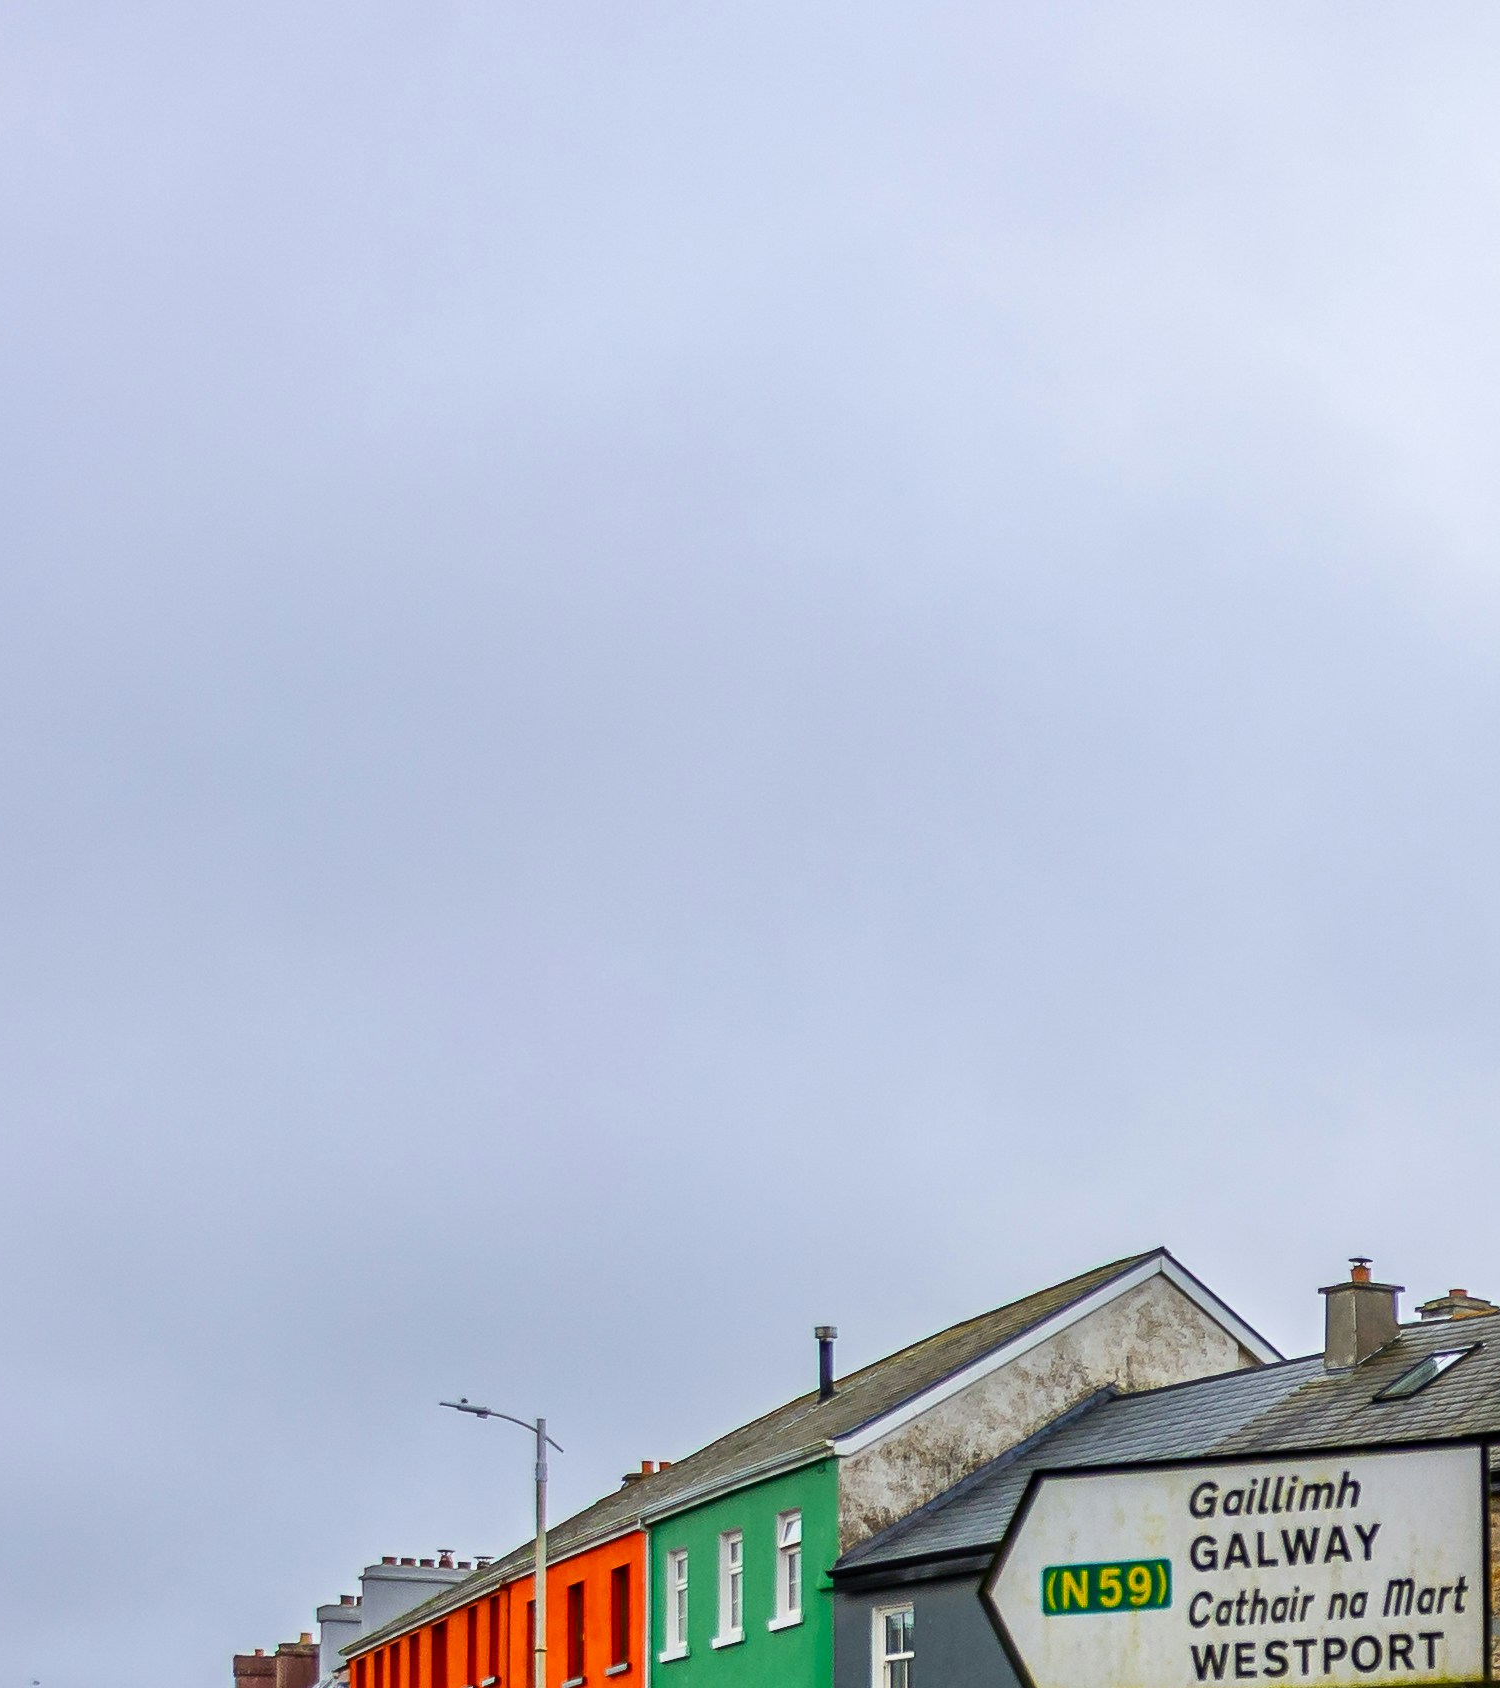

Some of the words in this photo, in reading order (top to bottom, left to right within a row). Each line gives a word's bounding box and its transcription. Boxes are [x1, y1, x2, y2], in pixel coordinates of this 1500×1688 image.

[1189, 1471, 1362, 1519] Gaillimh
[1190, 1523, 1381, 1572] GALWAY
[1189, 1585, 1315, 1628] Cathair
[1328, 1591, 1368, 1621] na
[1383, 1576, 1470, 1617] Mart
[1190, 1631, 1445, 1681] WESTPORT
